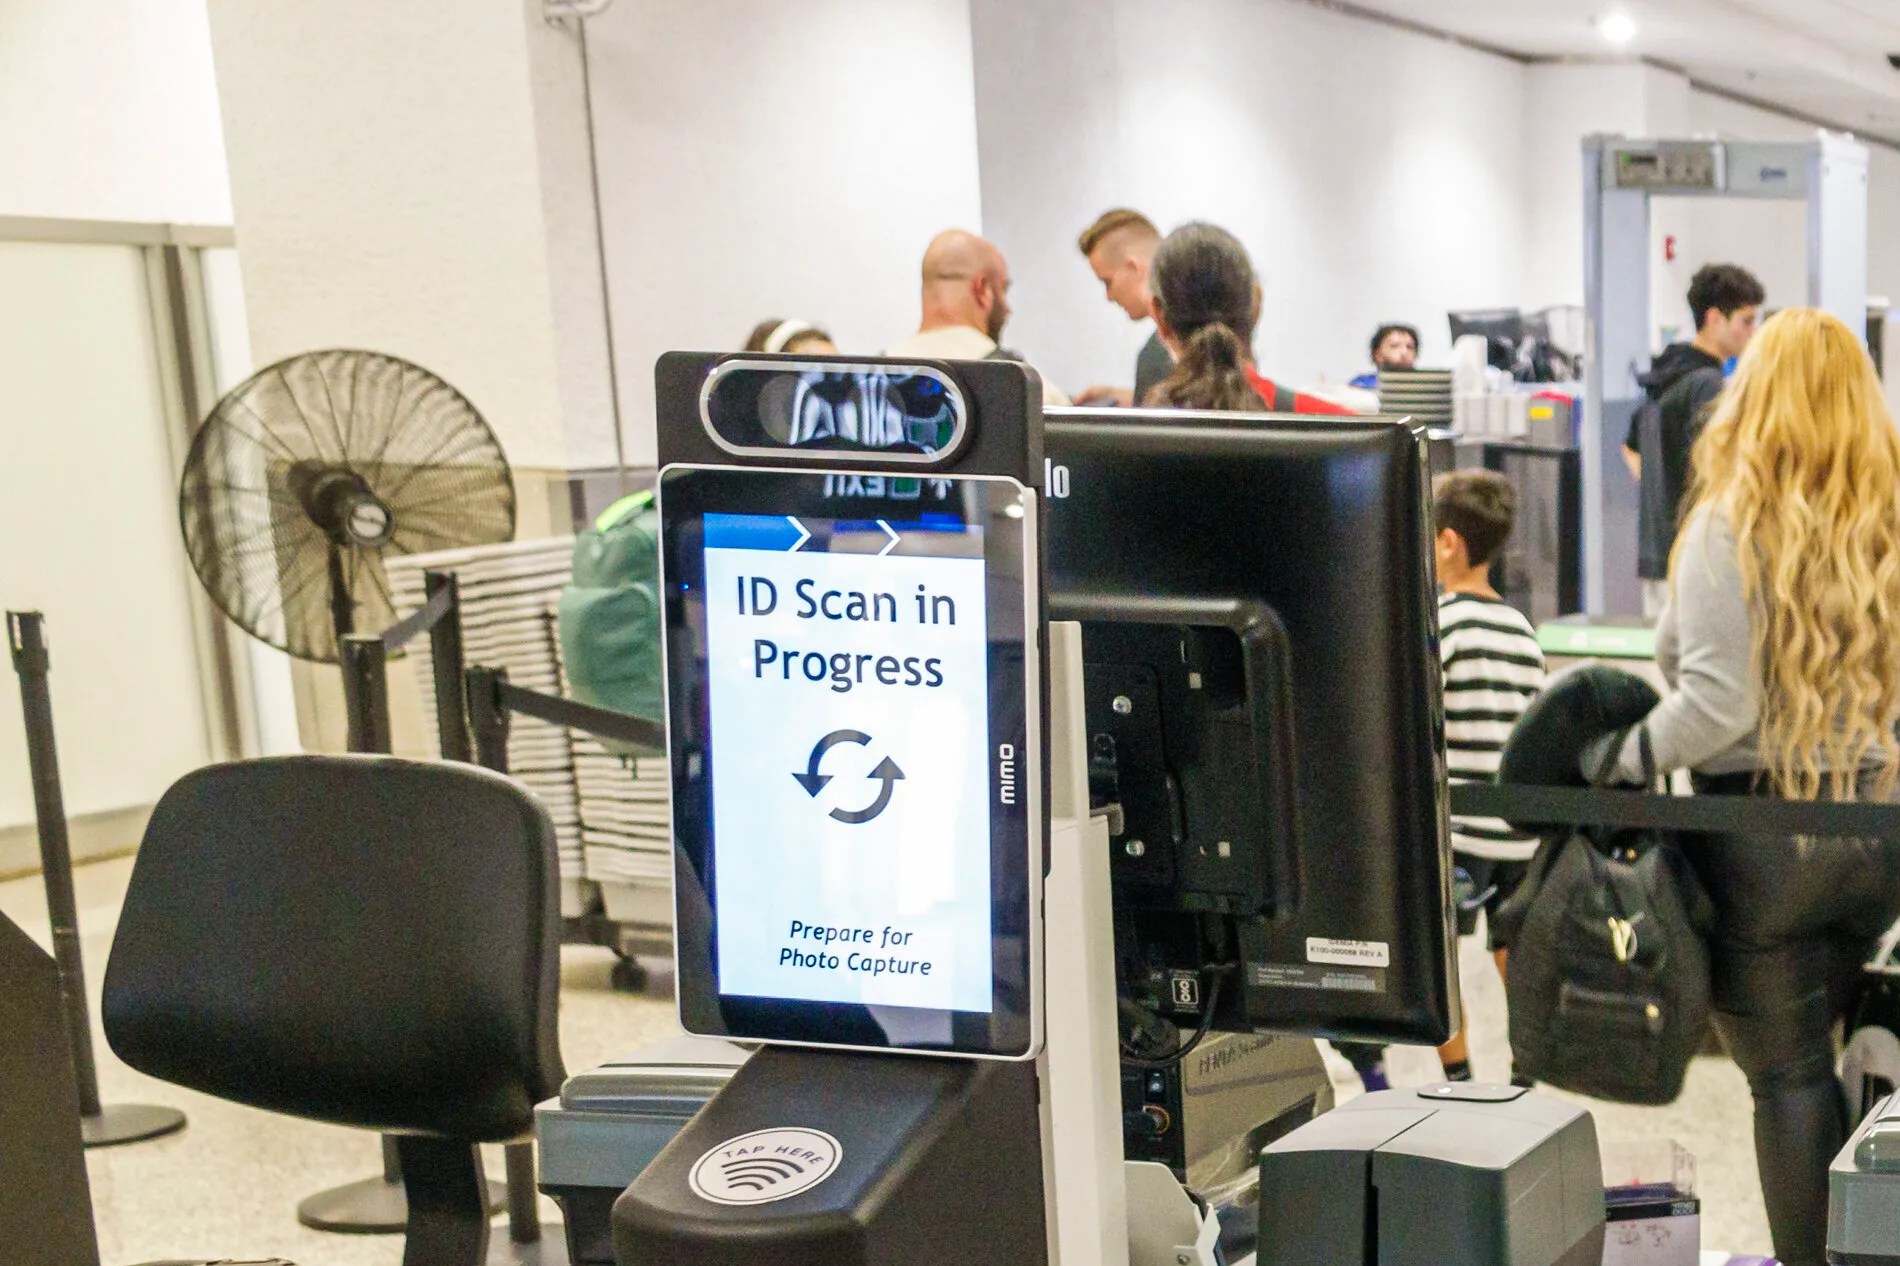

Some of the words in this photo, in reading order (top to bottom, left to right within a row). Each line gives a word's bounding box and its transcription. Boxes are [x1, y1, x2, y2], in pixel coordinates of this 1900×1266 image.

[1045, 458, 1069, 498] lo
[737, 576, 777, 616] ID
[795, 578, 897, 623] Scan
[915, 584, 955, 625] in
[754, 639, 943, 693] Progress
[1000, 743, 1015, 804] mimo
[790, 920, 874, 945] Prepare
[880, 926, 913, 949] for
[779, 948, 839, 969] Photo
[847, 952, 932, 977] Capture
[724, 1146, 764, 1158] TAP
[774, 1145, 824, 1165] HERE
